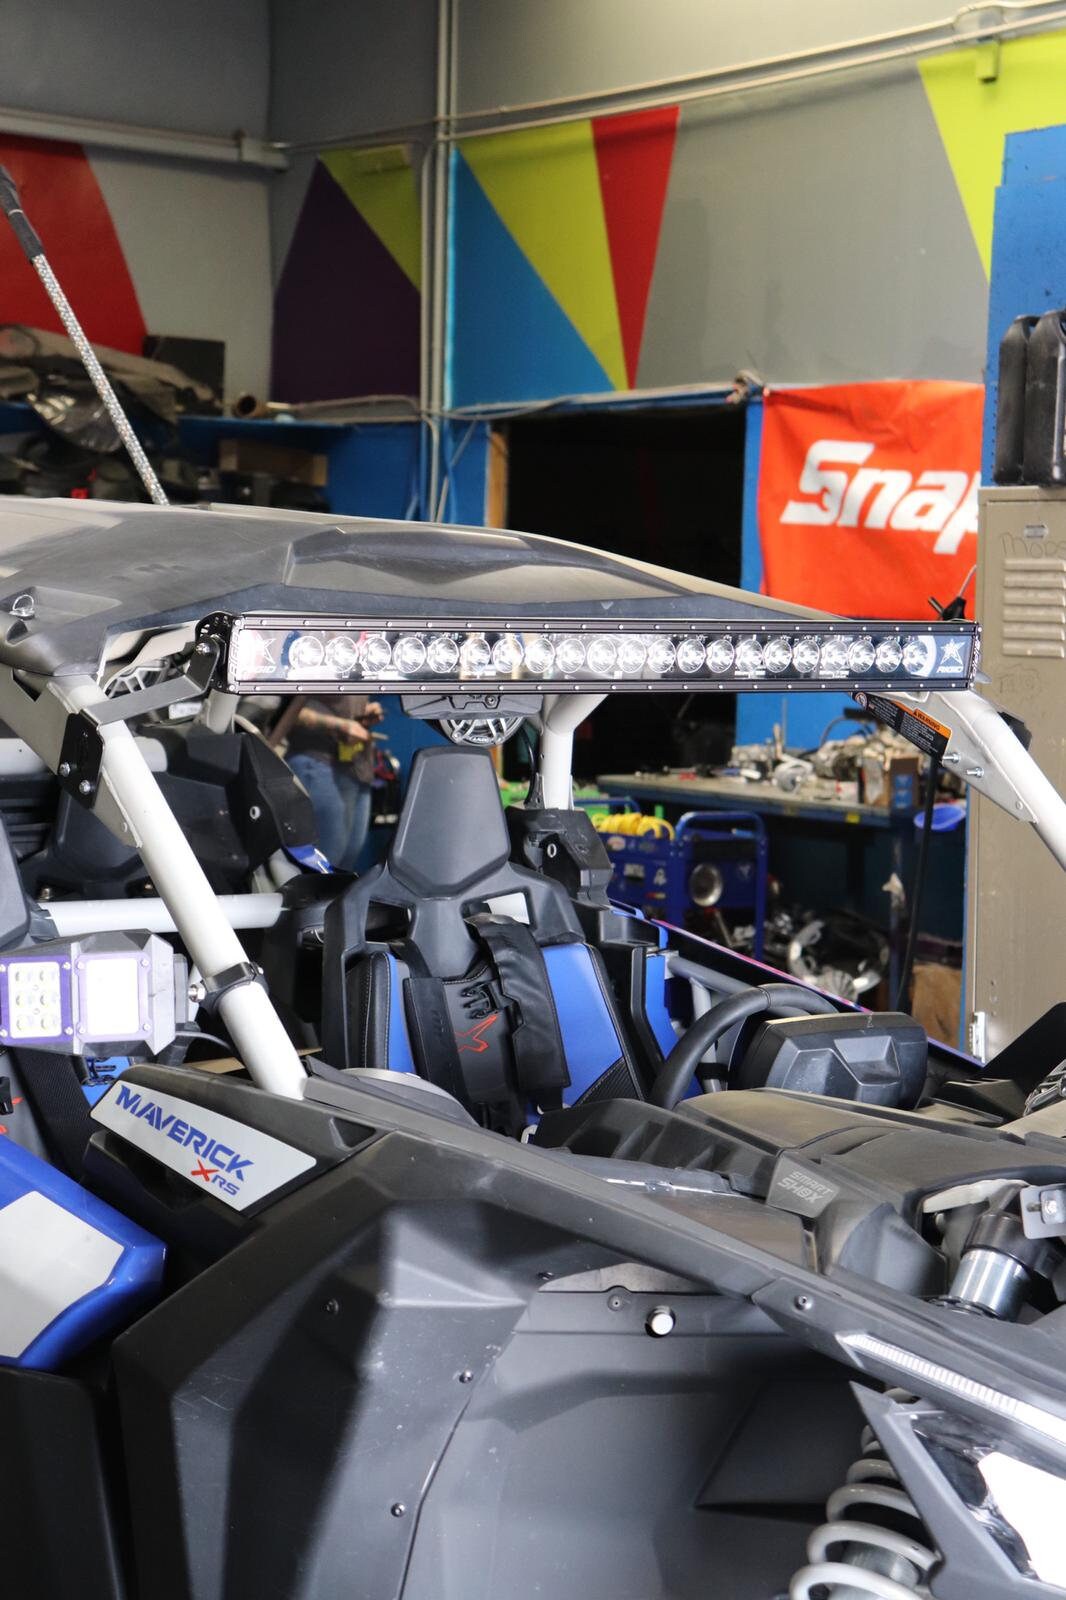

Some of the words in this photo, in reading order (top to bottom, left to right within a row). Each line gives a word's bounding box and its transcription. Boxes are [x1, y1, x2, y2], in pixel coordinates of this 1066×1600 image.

[917, 711, 941, 731] WARNING
[115, 1084, 255, 1182] MAVERICK
[777, 1177, 824, 1204] SHOX
[790, 1170, 834, 1196] SMART
